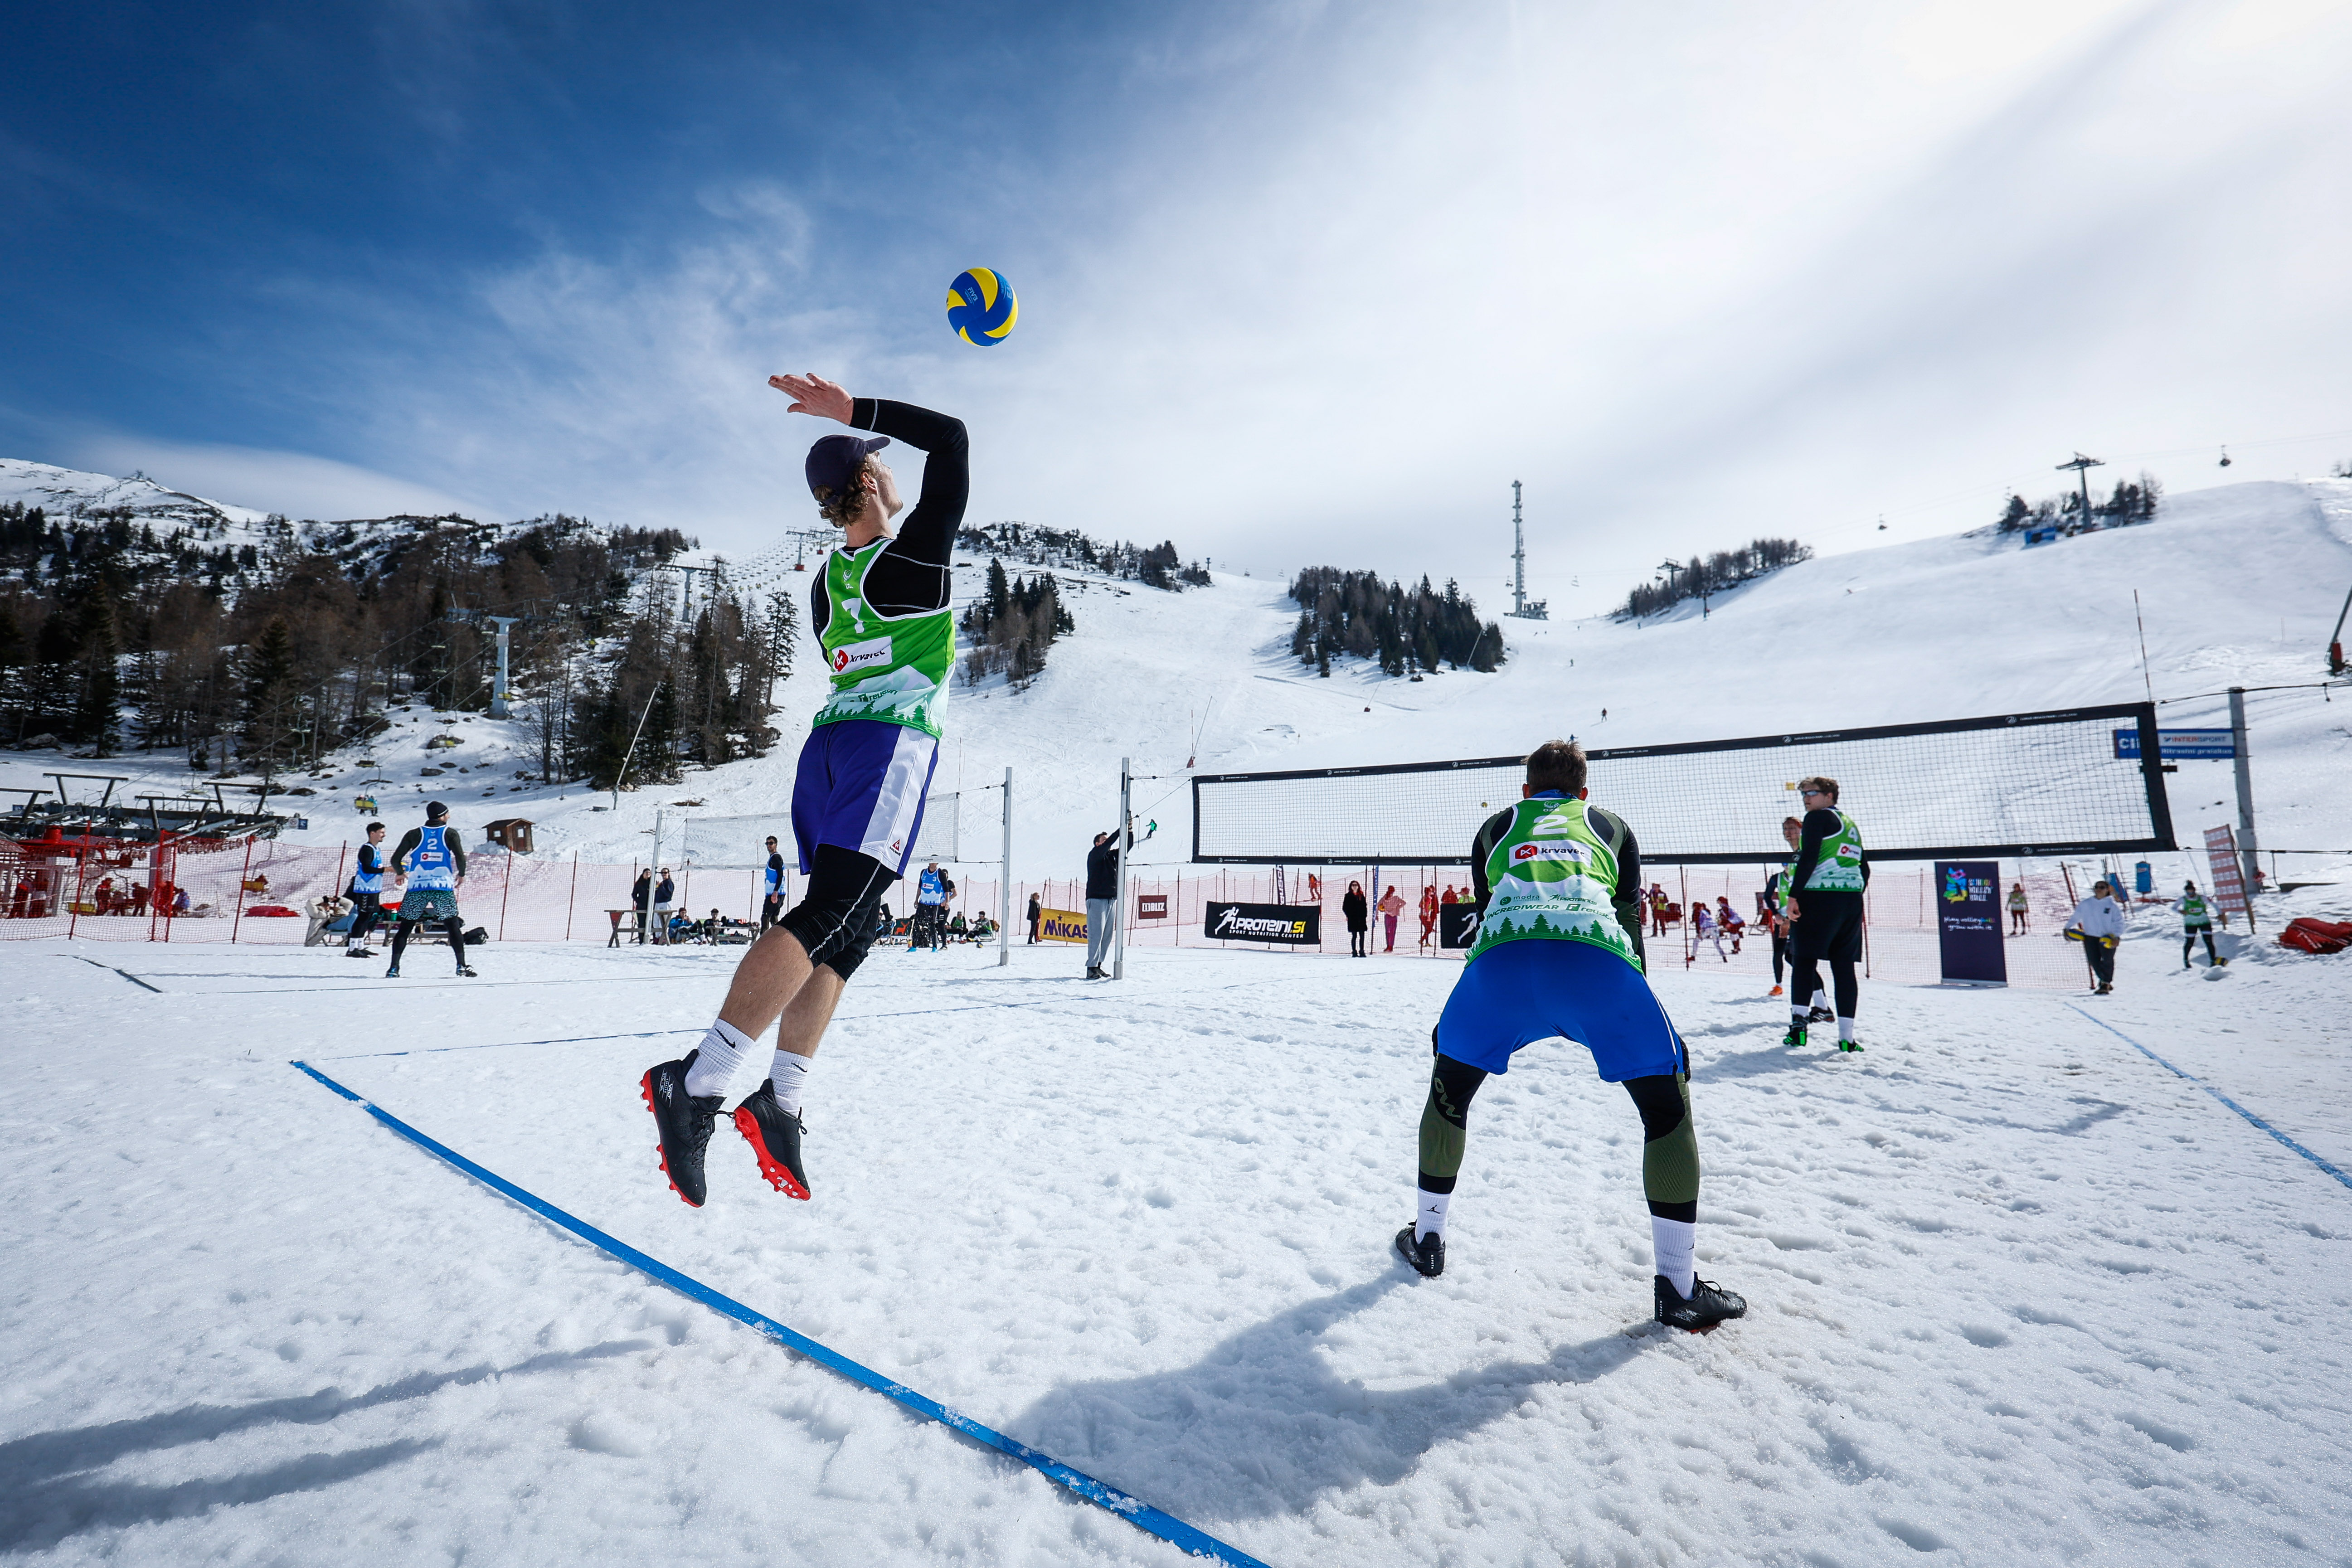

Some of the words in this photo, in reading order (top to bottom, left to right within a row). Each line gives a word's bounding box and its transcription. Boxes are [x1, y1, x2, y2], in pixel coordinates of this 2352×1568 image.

[967, 287, 978, 301] FIVB
[1533, 815, 1568, 835] 2
[1848, 827, 1858, 842] 4
[427, 838, 438, 850] 2
[1487, 904, 1560, 922] INCREDIWEAR
[1580, 907, 1614, 923] reusch
